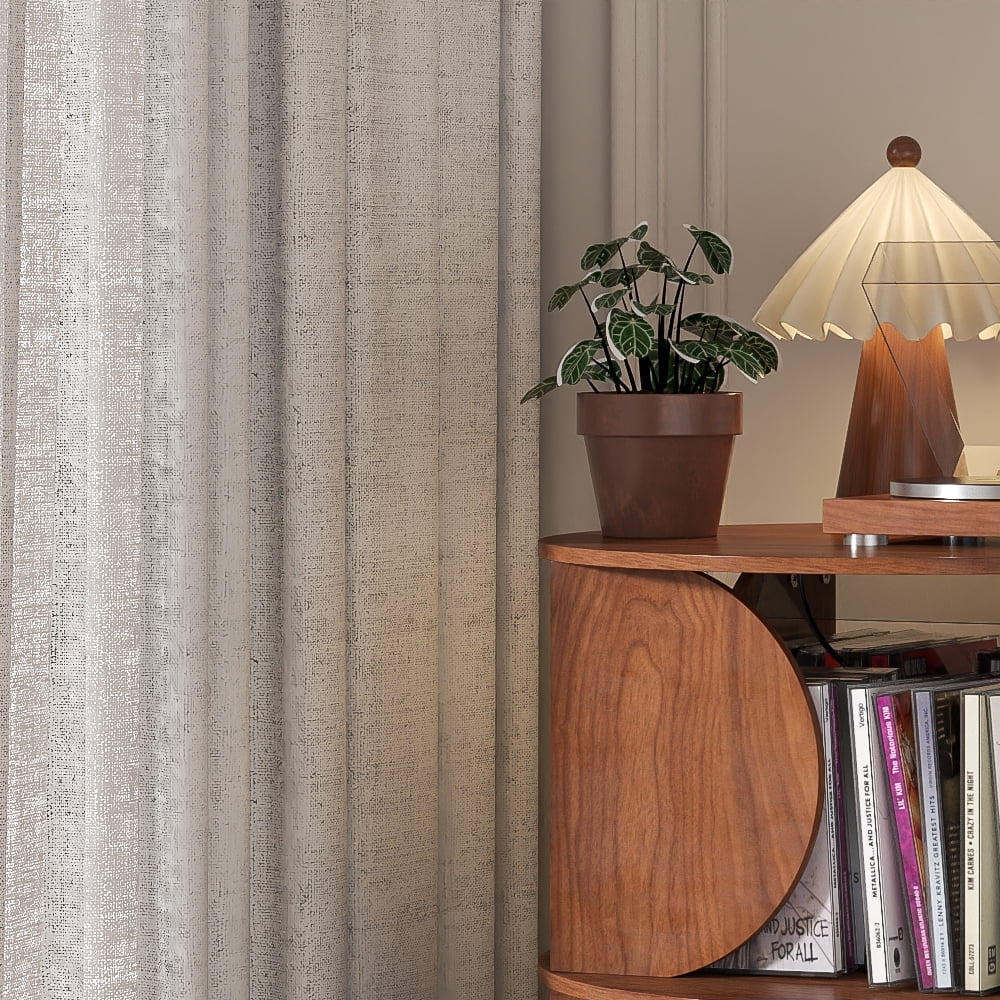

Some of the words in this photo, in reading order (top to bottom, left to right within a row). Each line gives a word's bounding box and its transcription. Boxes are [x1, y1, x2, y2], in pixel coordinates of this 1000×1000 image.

[857, 703, 865, 727] Vertigo
[882, 706, 891, 719] KIM
[886, 721, 896, 759] Notorious
[892, 761, 900, 774] The
[895, 783, 903, 796] KIM
[966, 770, 974, 791] NIGHT
[967, 848, 975, 875] CARNES
[934, 862, 942, 895] KRAVITZ
[936, 900, 944, 926] LENNY
[780, 916, 828, 937] JUSTICE
[771, 942, 795, 961] FOR
[796, 942, 818, 962] ALL
